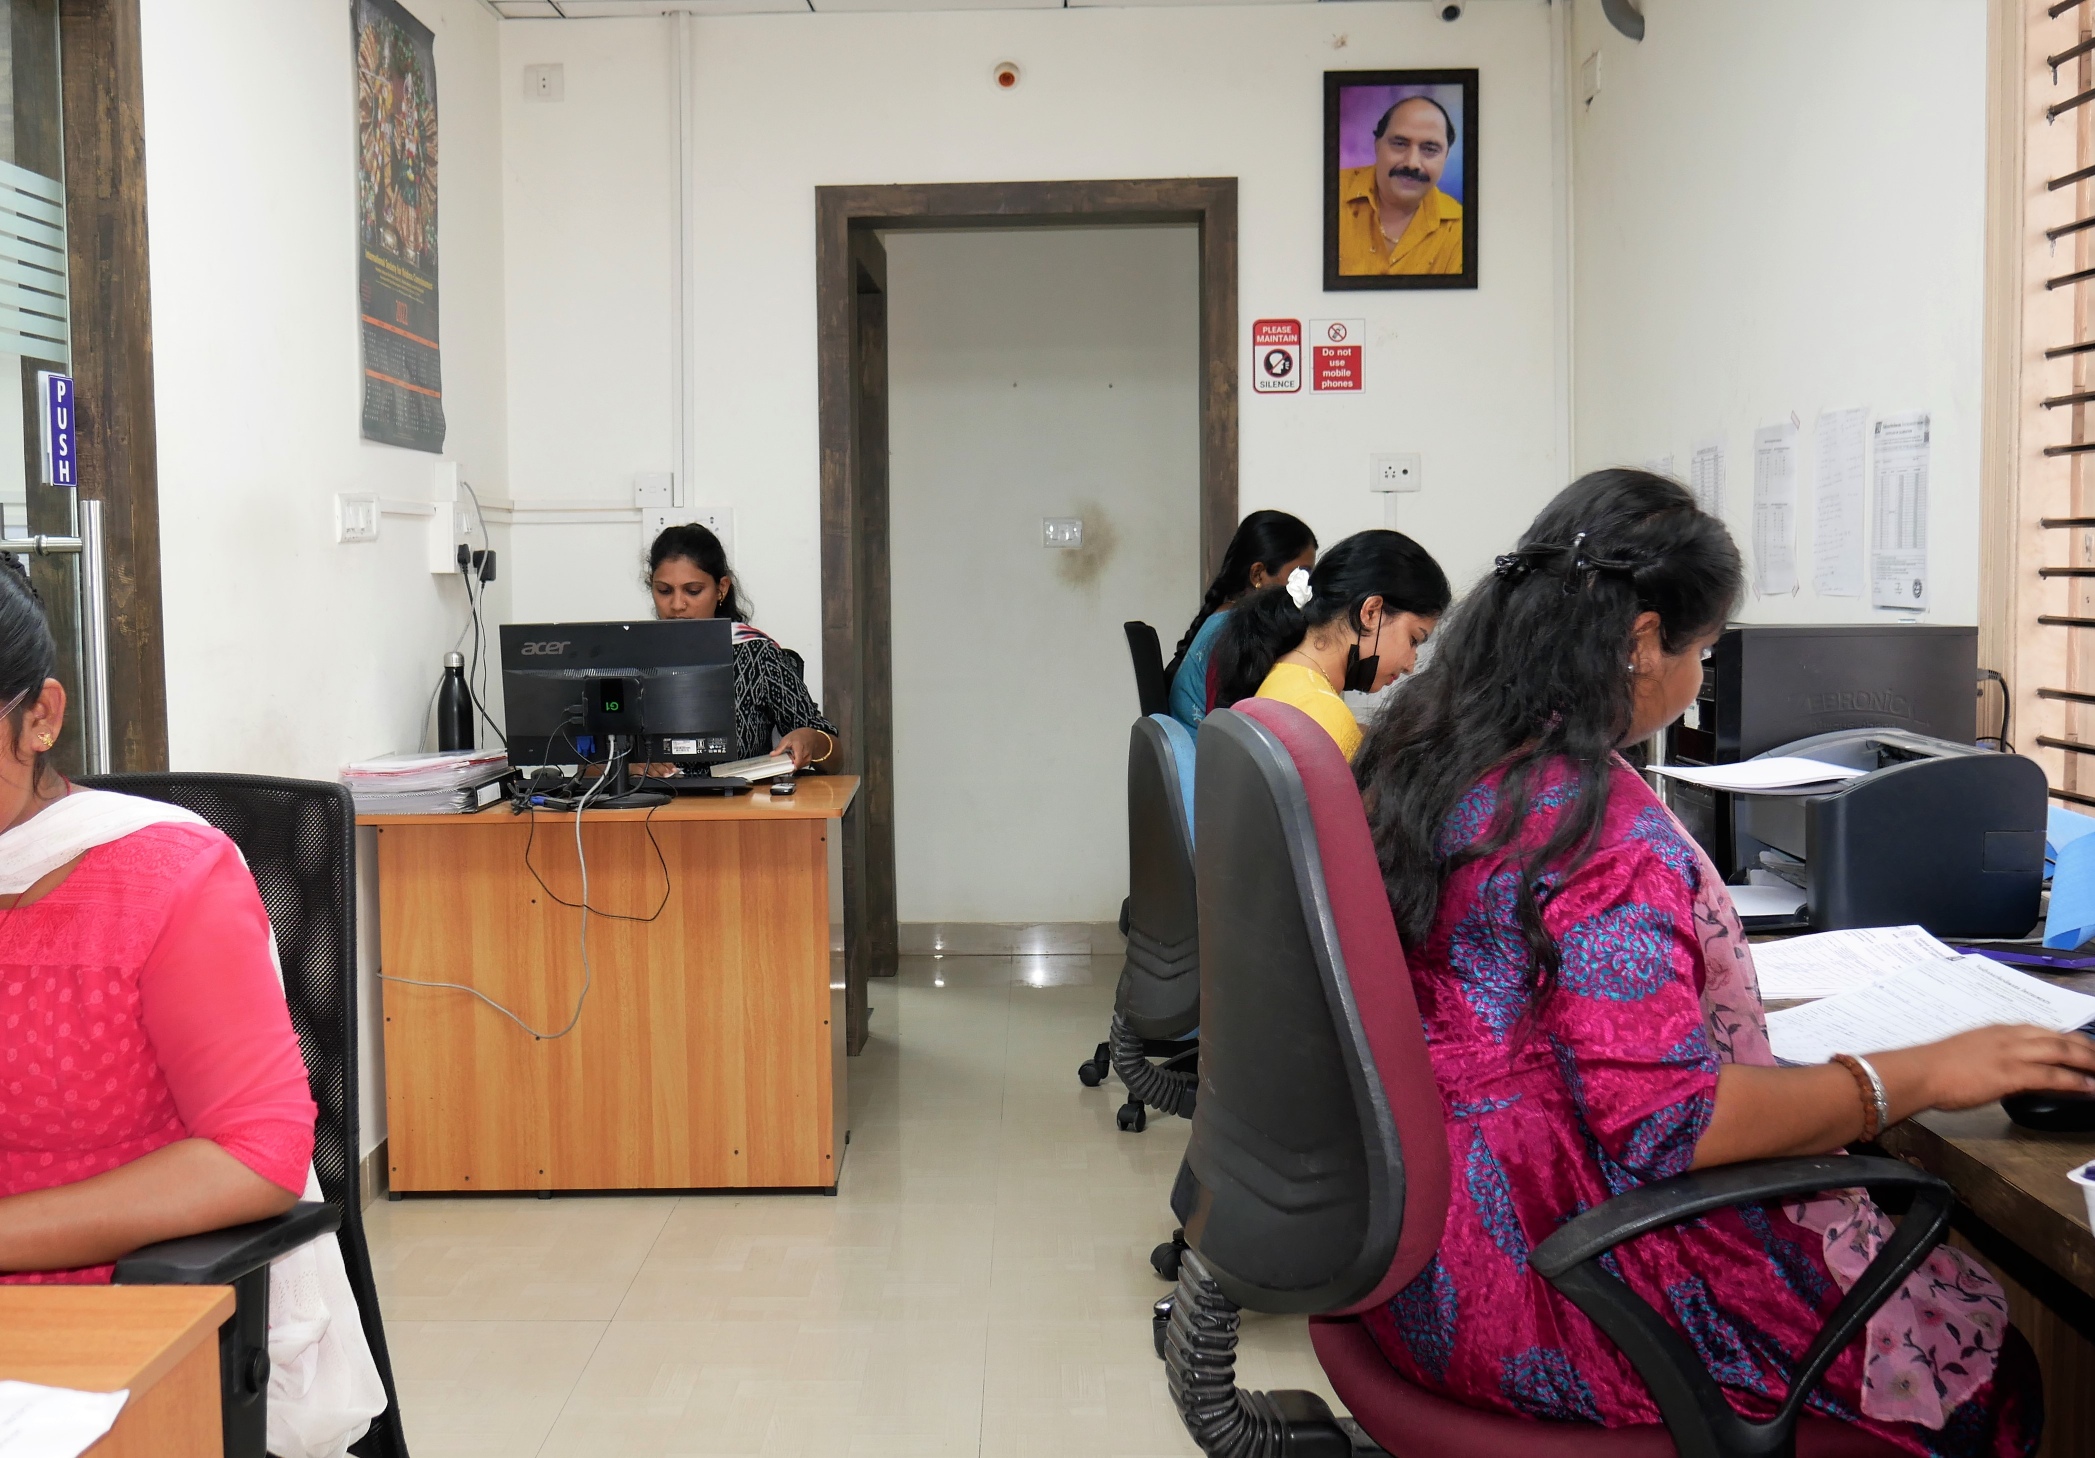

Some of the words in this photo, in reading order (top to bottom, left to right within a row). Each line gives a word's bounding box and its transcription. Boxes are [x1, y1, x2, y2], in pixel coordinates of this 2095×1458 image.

[1262, 326, 1292, 334] PLEASE
[1256, 334, 1298, 343] MAINTAIN
[1322, 348, 1334, 356] Do
[1337, 348, 1352, 356] not
[1260, 380, 1295, 388] SILENCE
[1322, 379, 1353, 389] phones
[57, 380, 70, 482] PUSH
[521, 641, 571, 655] acer
